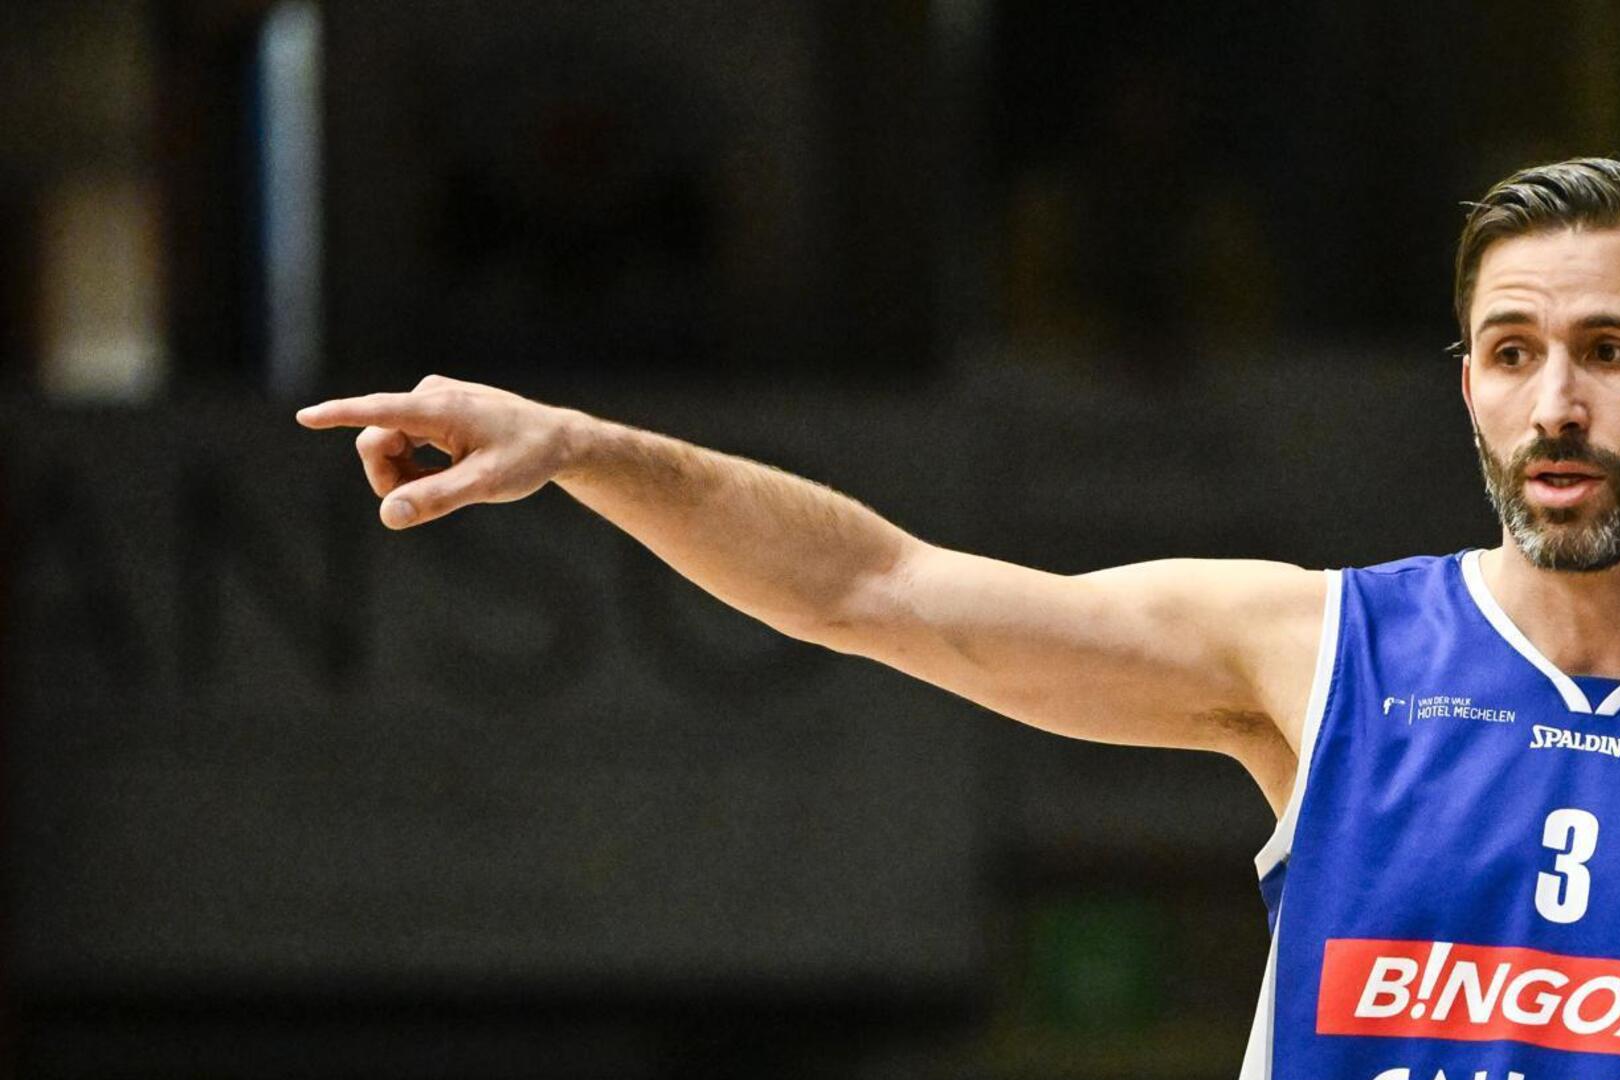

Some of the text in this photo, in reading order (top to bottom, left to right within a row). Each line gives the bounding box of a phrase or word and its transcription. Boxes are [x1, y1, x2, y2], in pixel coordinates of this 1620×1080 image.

[1417, 705, 1516, 723] HOTEL MECHELEN
[1534, 808, 1600, 924] 3
